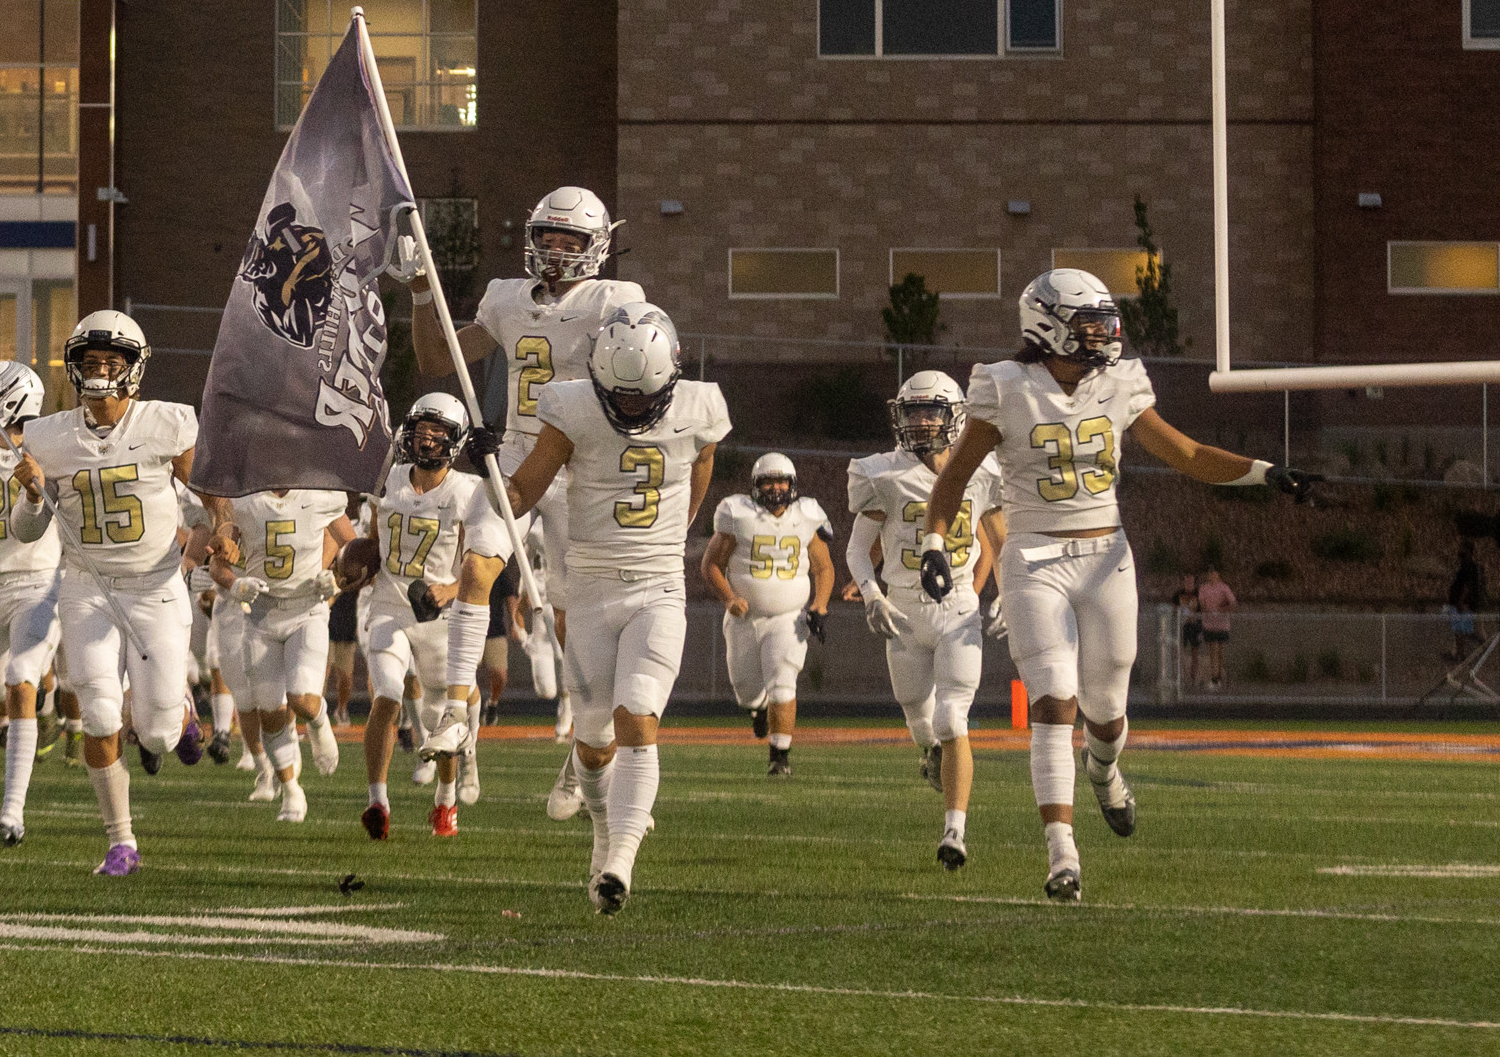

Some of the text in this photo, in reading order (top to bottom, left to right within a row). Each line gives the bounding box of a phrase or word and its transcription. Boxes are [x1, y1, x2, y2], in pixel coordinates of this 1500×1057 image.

[515, 335, 555, 417] 2
[613, 445, 665, 528] 3
[1029, 415, 1118, 503] 33
[72, 463, 146, 544] 15
[901, 499, 975, 571] 34
[263, 519, 296, 580] 5
[385, 511, 441, 579] 17
[750, 534, 801, 581] 53
